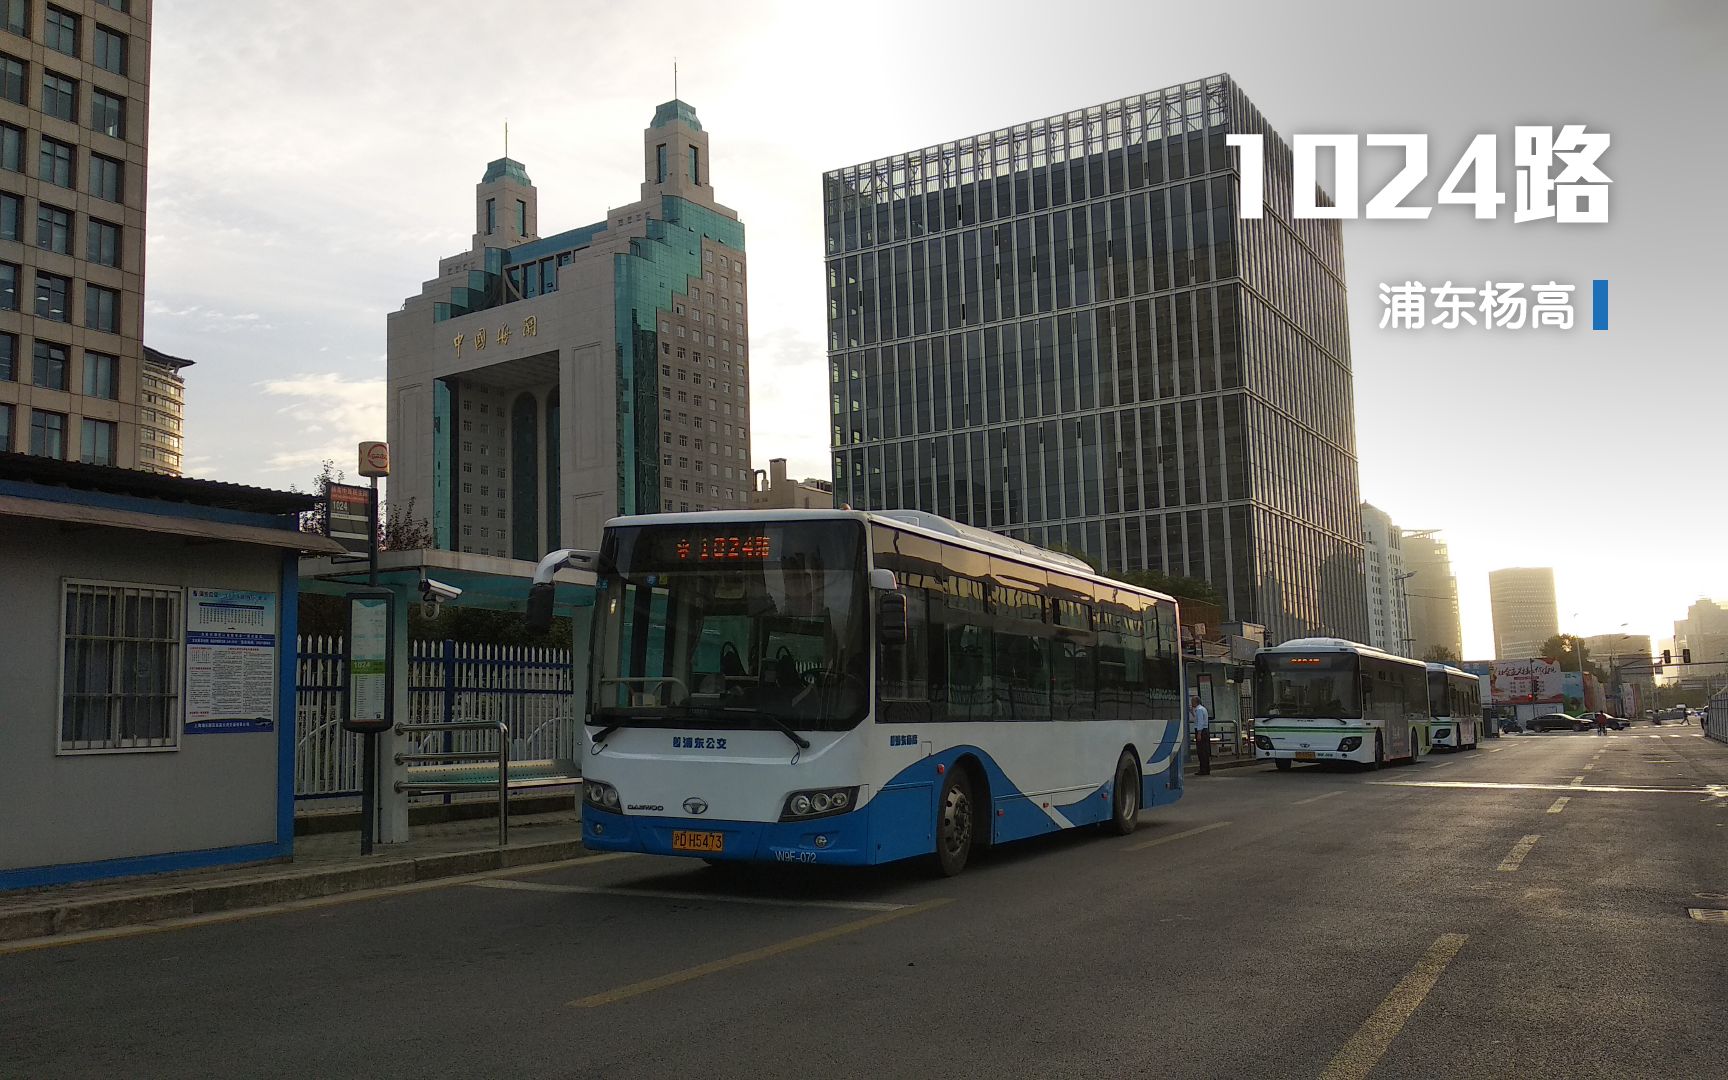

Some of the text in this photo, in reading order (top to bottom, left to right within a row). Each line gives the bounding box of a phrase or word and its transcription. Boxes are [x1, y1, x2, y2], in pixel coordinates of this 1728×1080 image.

[333, 501, 348, 511] 1024
[701, 536, 770, 558] 1024路
[682, 736, 727, 750] 浦东公交
